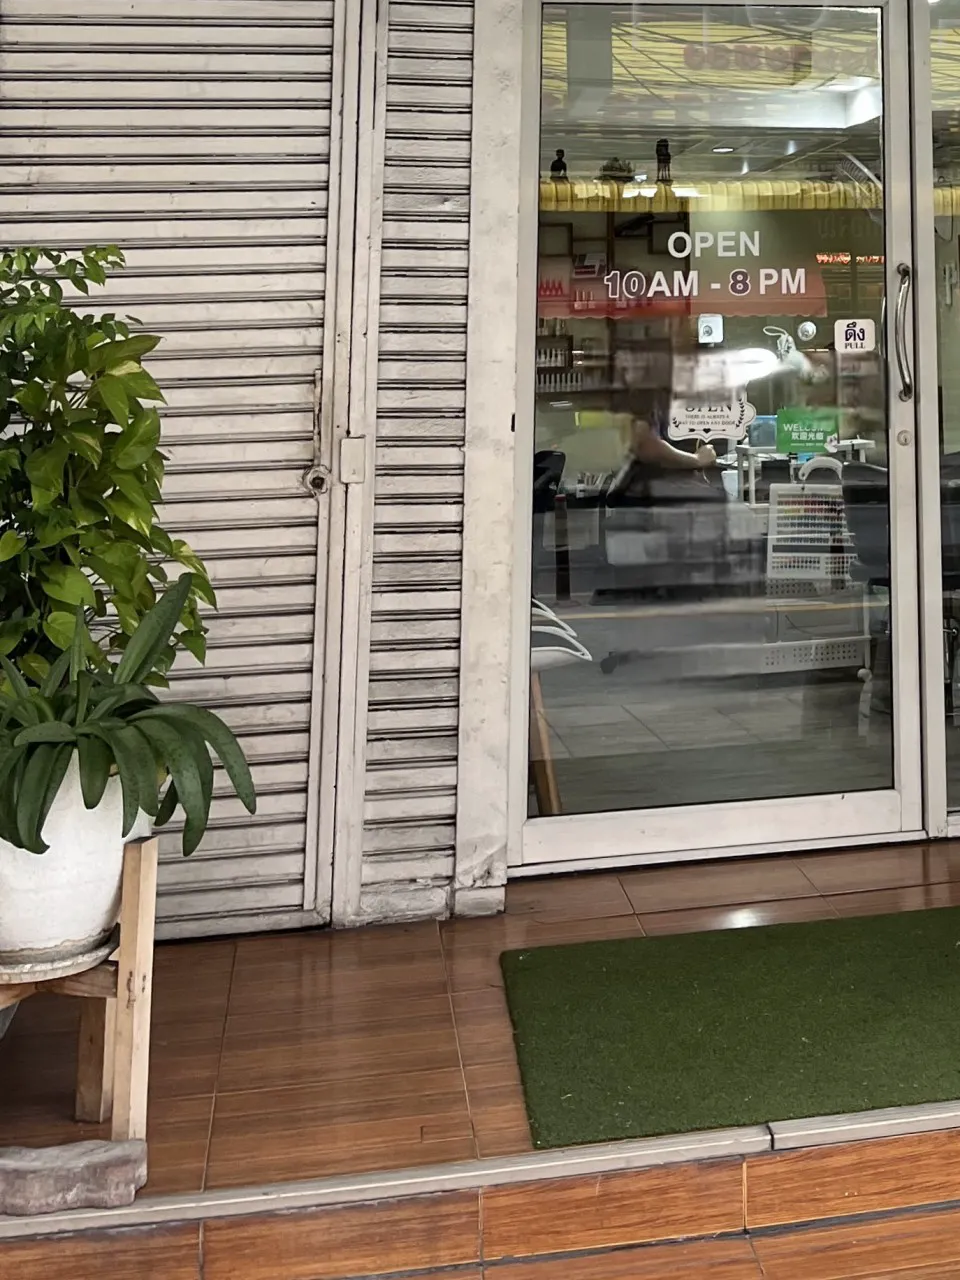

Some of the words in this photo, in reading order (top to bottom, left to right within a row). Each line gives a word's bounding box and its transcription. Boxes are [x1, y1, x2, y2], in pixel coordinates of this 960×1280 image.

[667, 230, 760, 258] OPEN
[604, 270, 698, 298] 10AM
[729, 268, 751, 296] 8
[759, 268, 806, 295] PM
[844, 321, 866, 342] ดึง
[844, 342, 866, 350] PULL
